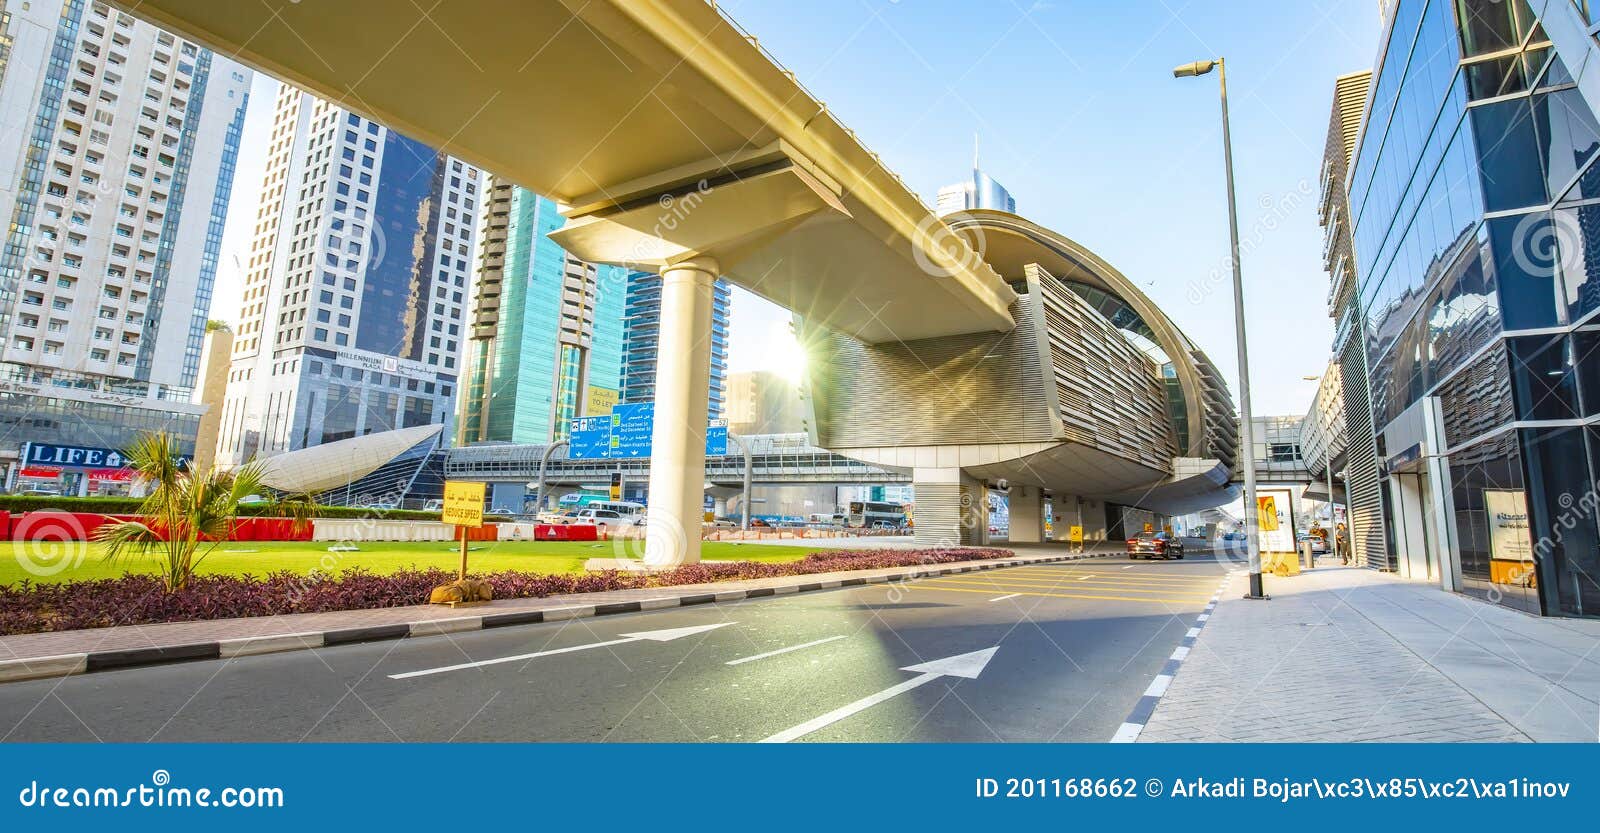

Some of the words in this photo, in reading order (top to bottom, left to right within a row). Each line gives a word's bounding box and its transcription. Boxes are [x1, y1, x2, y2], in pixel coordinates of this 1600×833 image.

[337, 351, 382, 364] MILLENNIUM
[13, 384, 40, 393] Tower
[31, 445, 103, 465] LIFE
[445, 507, 464, 518] REDUCE
[464, 508, 480, 519] SPEED
